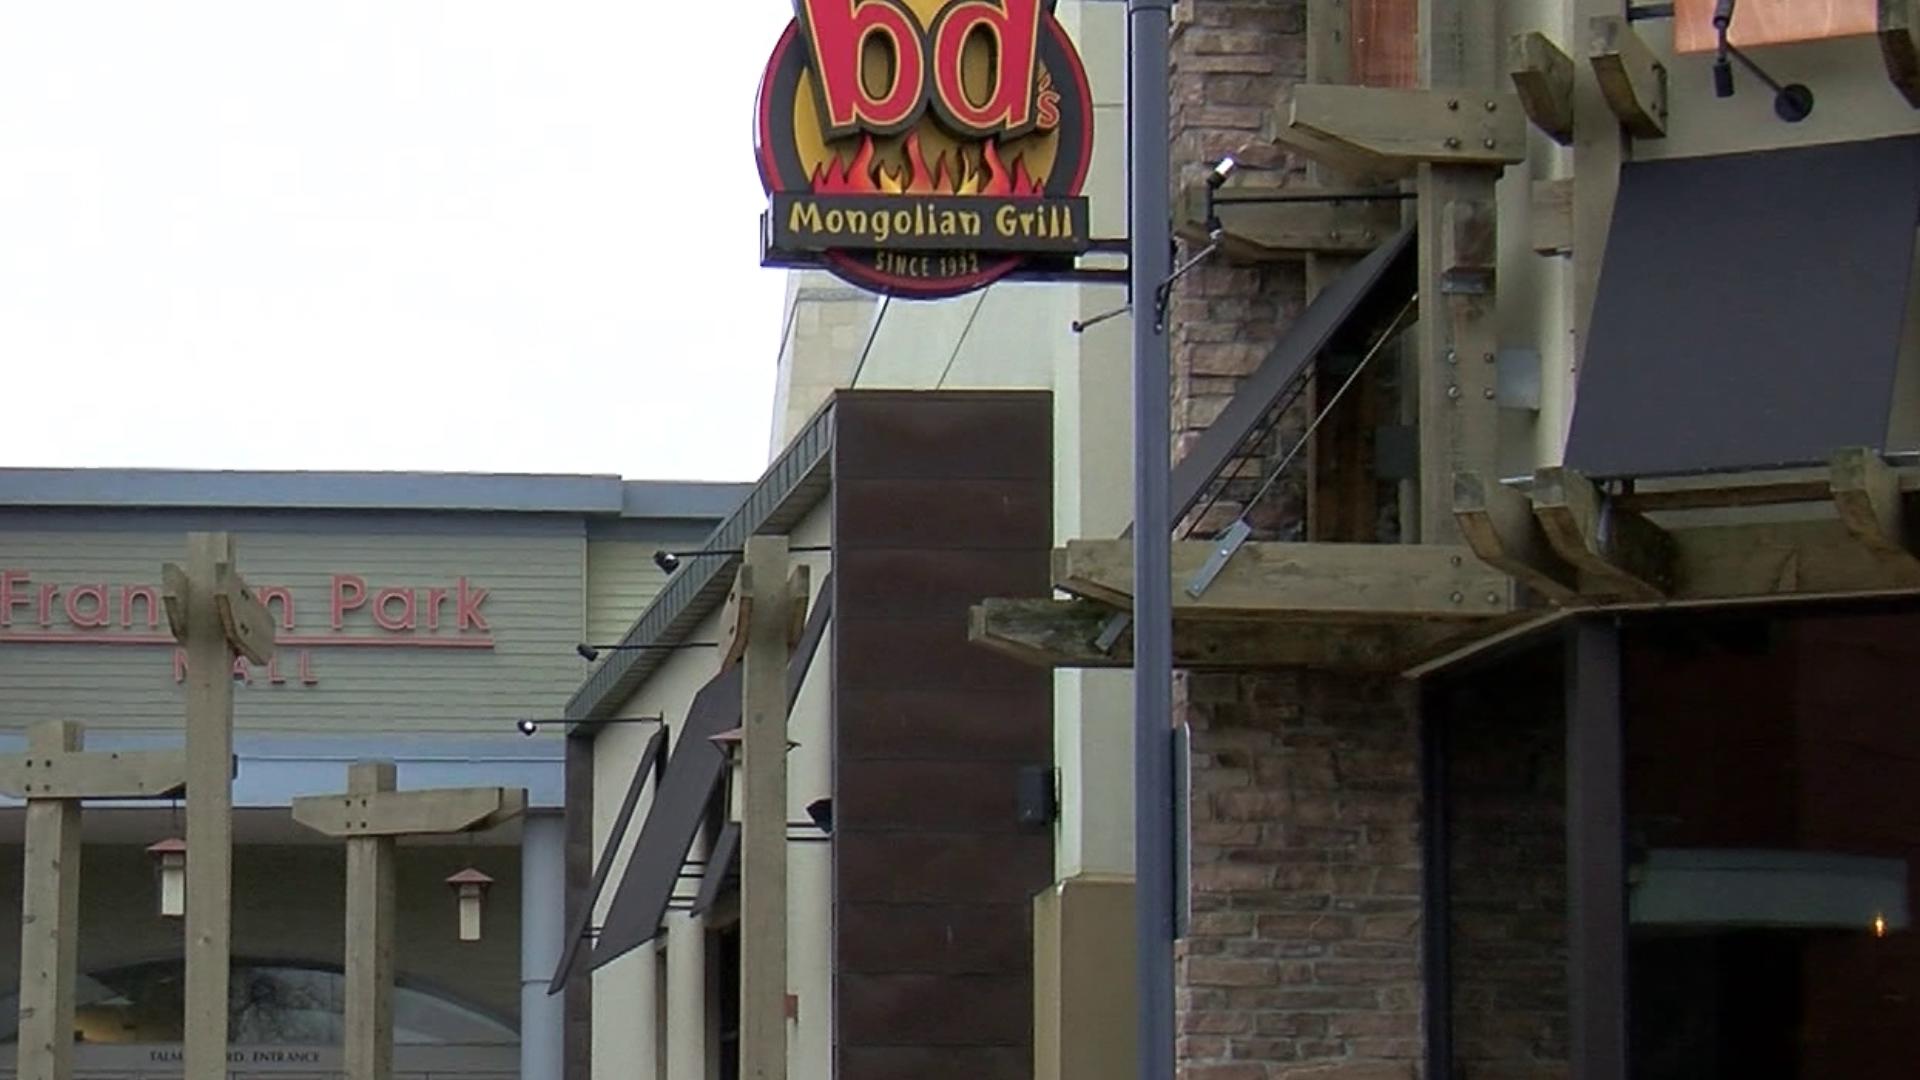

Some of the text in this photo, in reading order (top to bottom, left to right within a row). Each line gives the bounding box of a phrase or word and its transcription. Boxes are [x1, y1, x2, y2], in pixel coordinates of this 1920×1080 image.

[789, 201, 1073, 242] Mongolian Grill
[875, 251, 979, 277] SINCE 1992
[0, 569, 490, 630] Frann Park
[252, 1051, 320, 1062] ENTRANCE
